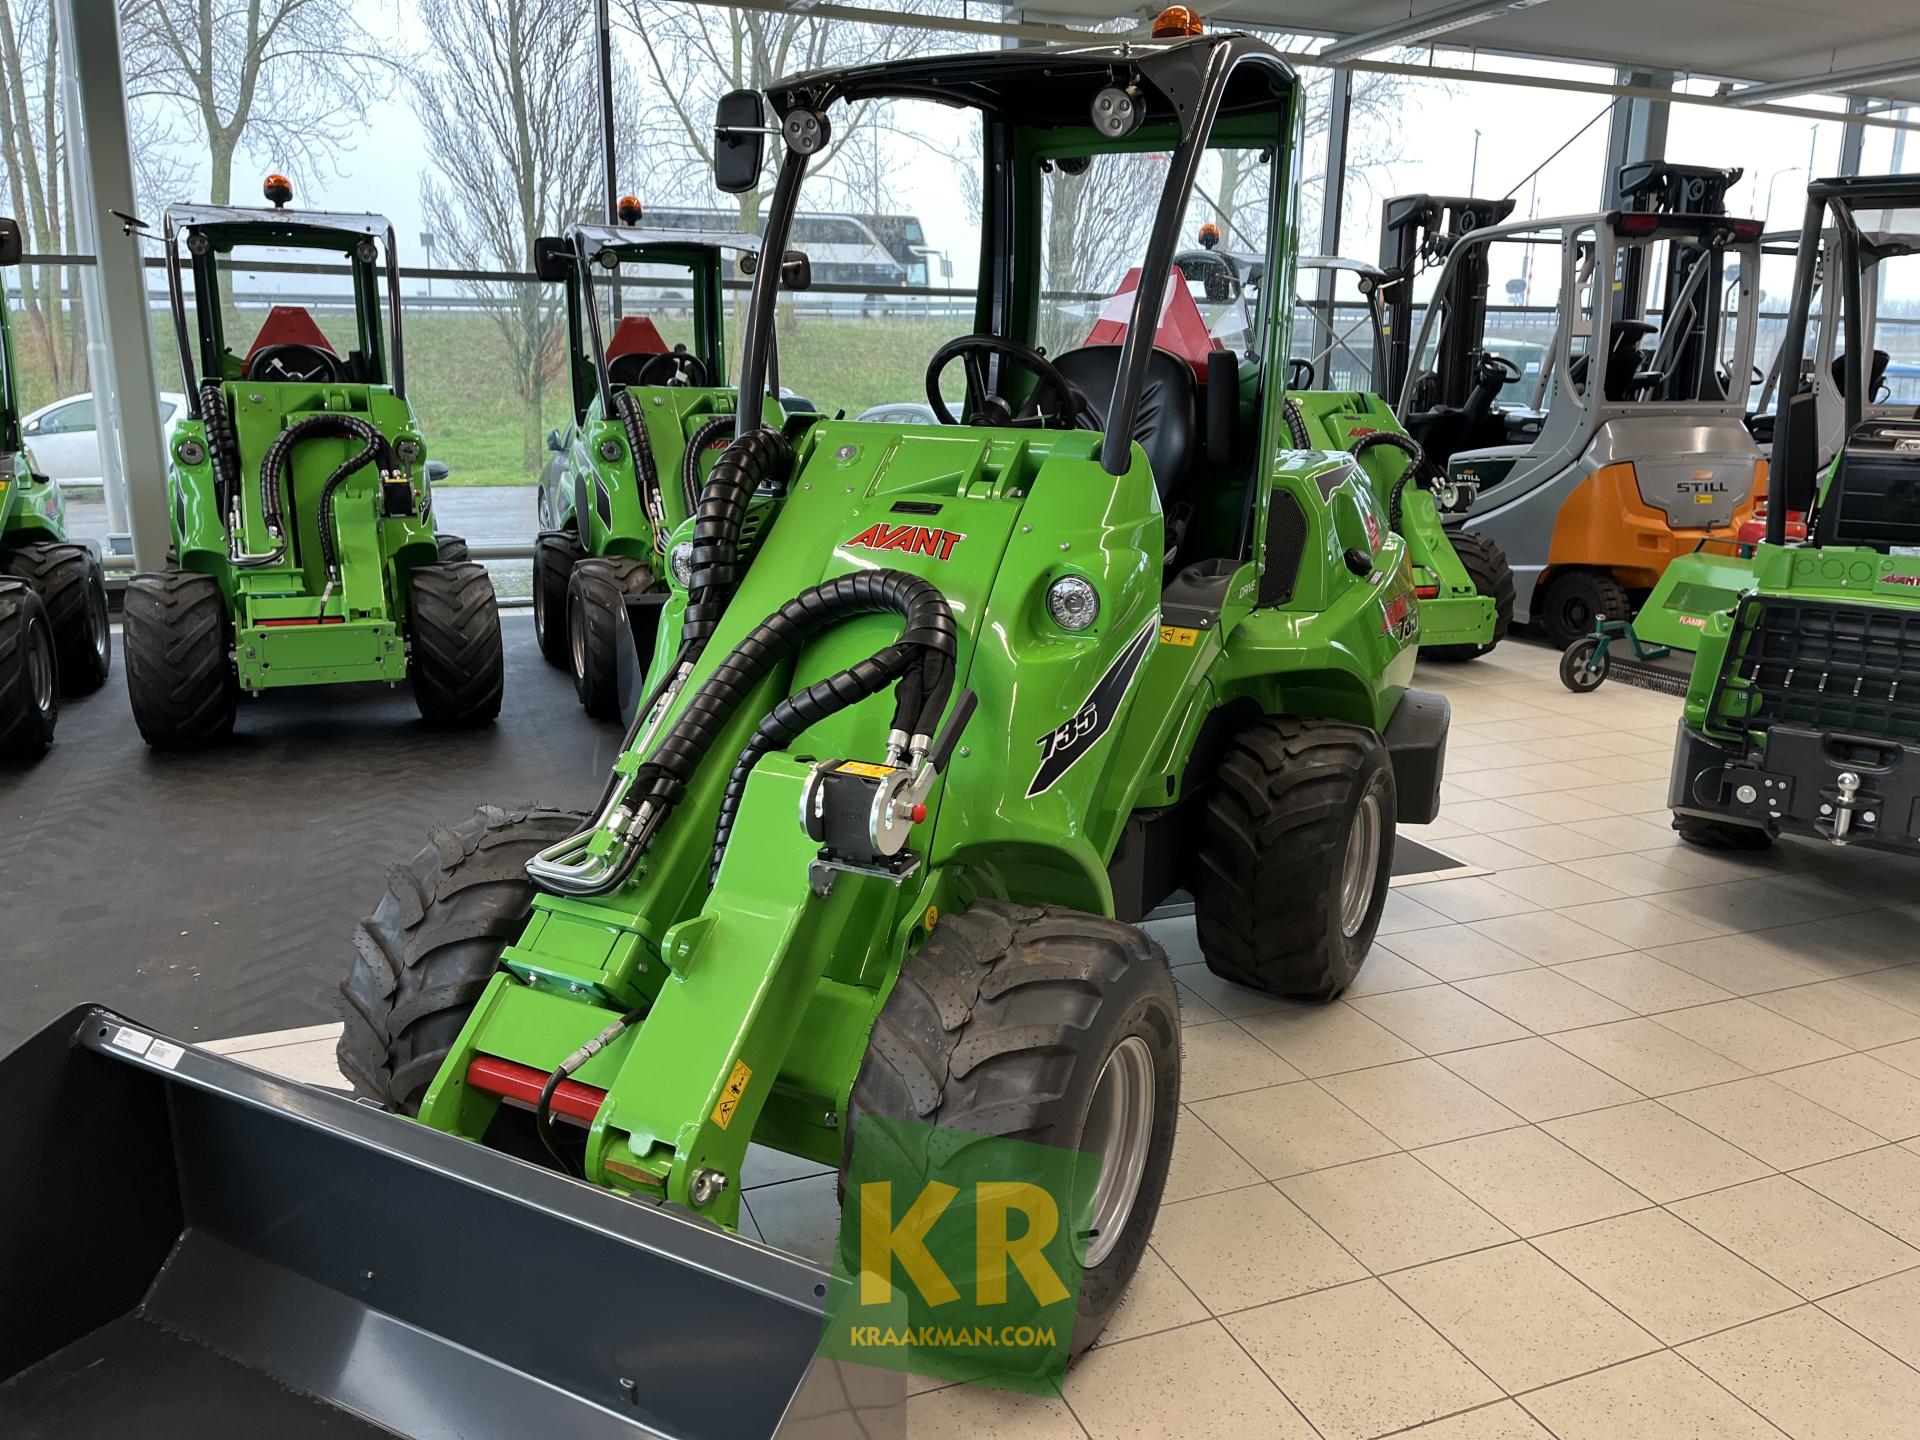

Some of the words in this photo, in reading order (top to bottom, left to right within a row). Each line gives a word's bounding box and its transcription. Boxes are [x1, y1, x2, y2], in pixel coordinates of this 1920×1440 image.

[1456, 473, 1481, 482] STILL
[1677, 482, 1729, 493] STILL
[841, 522, 963, 561] AVANT
[1036, 702, 1098, 762] 735
